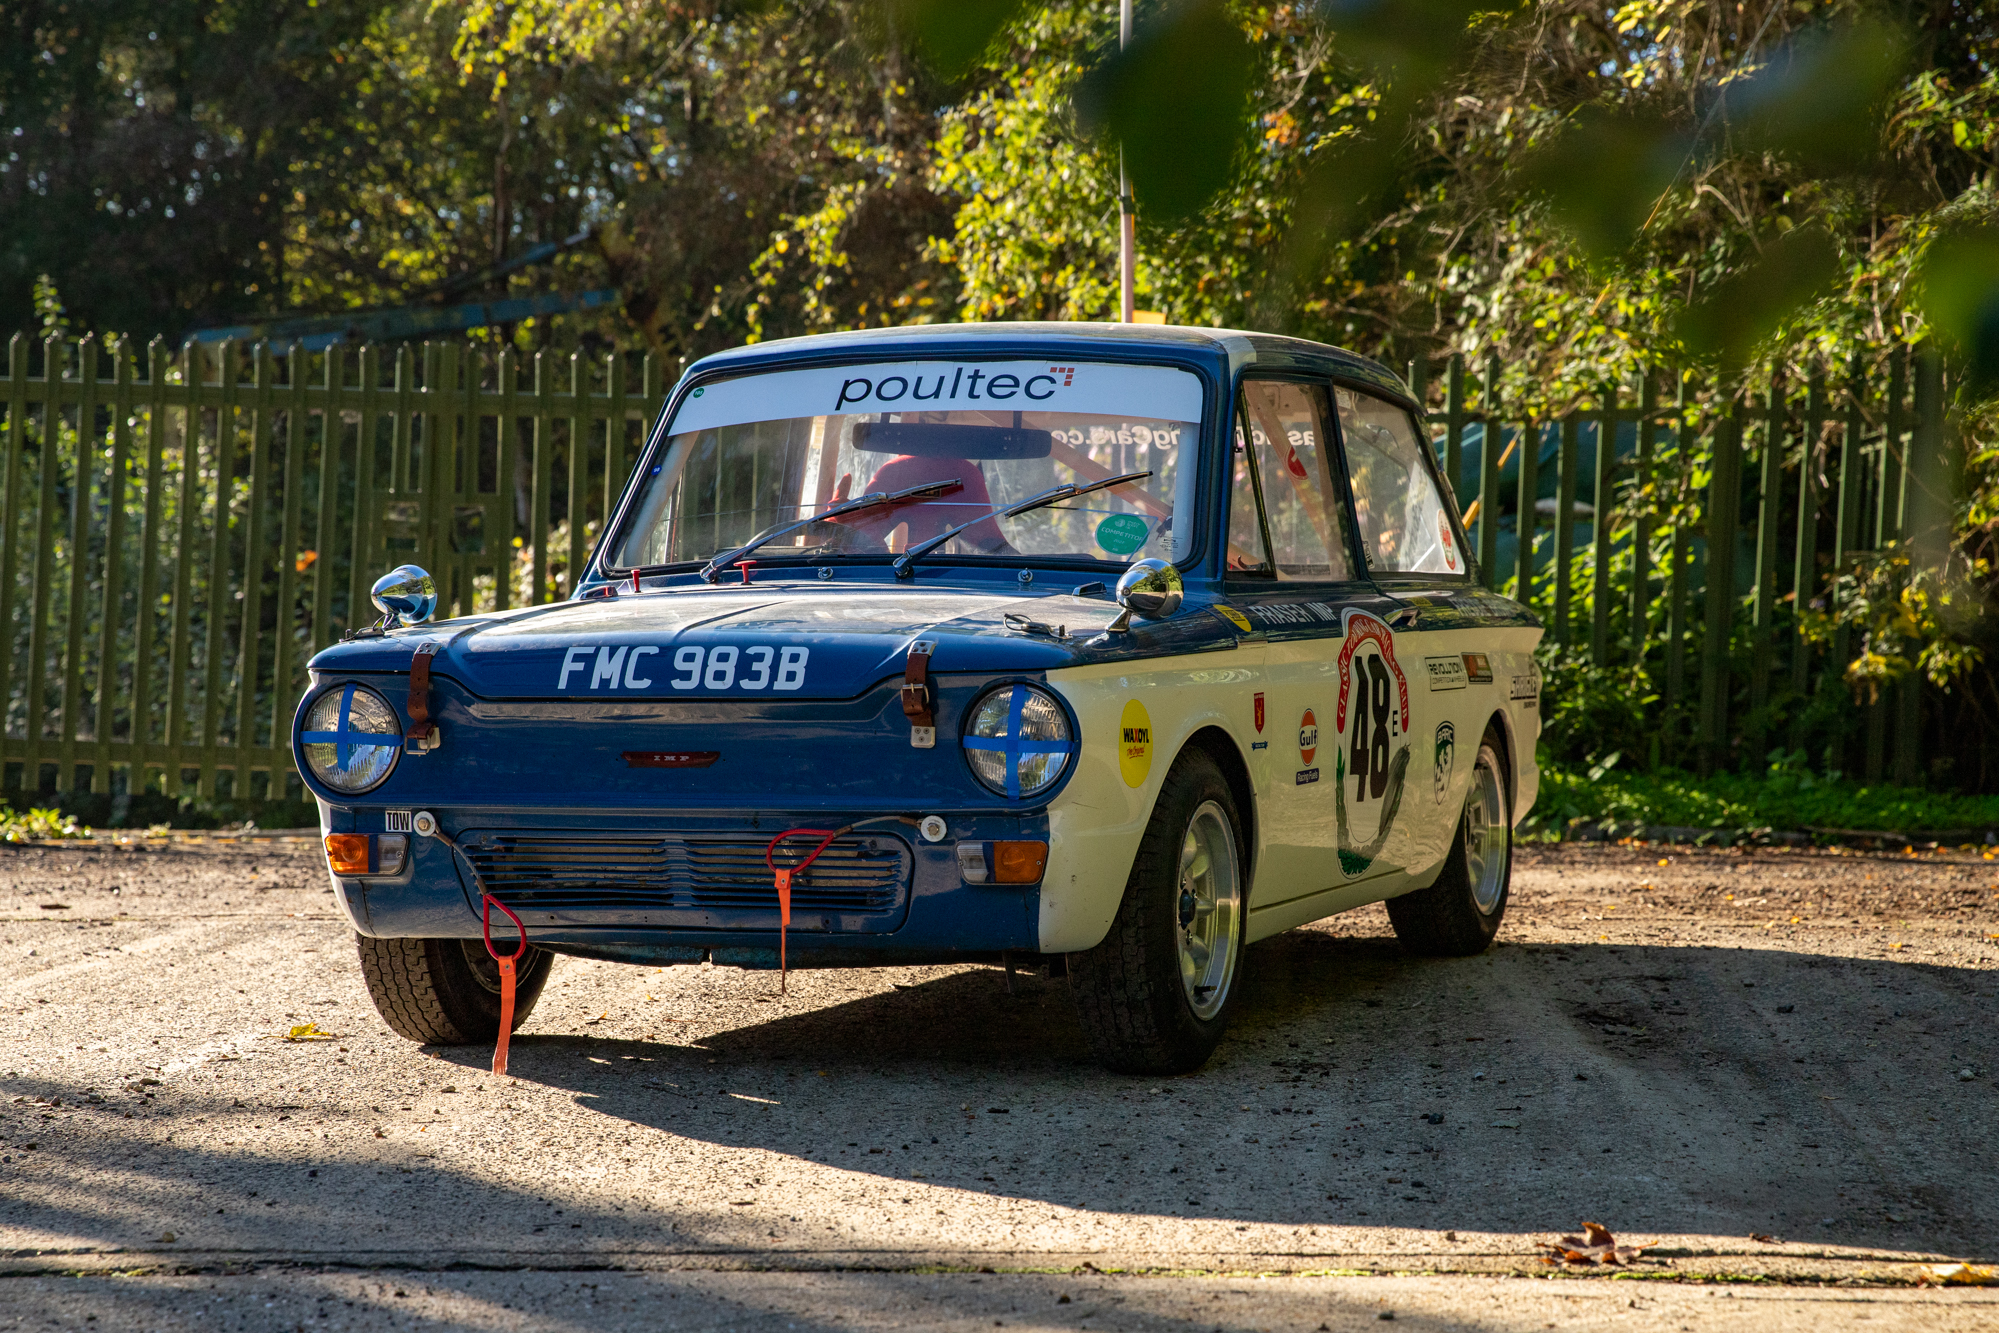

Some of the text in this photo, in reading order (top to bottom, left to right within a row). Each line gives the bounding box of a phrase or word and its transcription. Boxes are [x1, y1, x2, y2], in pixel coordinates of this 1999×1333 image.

[835, 366, 1058, 411] poultec
[1248, 603, 1315, 625] FRASER
[1304, 602, 1337, 621] IMP
[557, 645, 810, 691] FMC 983B
[1428, 662, 1463, 675] REVOLUTION
[1123, 727, 1149, 743] WAXOYL
[1300, 729, 1318, 747] Gulf
[1350, 653, 1398, 803] 48 E
[1297, 771, 1309, 783] Racing
[386, 811, 410, 831] TOW
